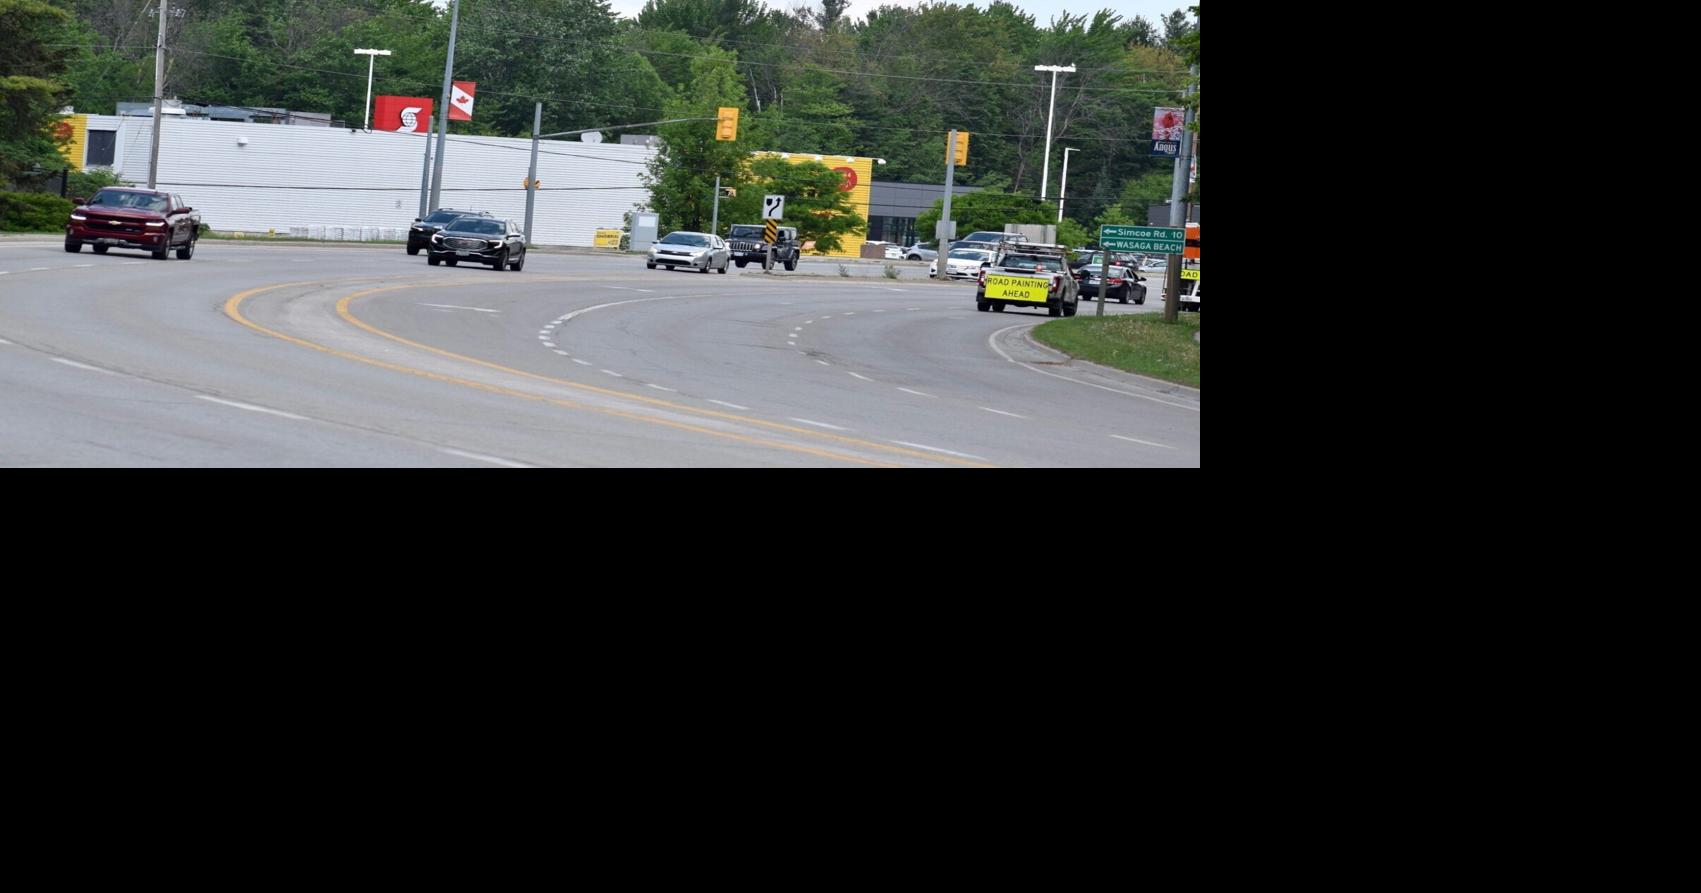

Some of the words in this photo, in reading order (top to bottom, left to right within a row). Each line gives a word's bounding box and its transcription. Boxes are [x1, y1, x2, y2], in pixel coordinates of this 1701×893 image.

[1153, 141, 1177, 153] Angus
[1117, 228, 1152, 237] Simcoe
[1153, 230, 1168, 238] Rd.
[1171, 231, 1183, 239] 10
[1116, 241, 1152, 250] WASAGA
[1153, 243, 1182, 251] BEACH
[987, 277, 1010, 286] ROAD
[1011, 279, 1049, 289] PAINTING
[1002, 289, 1031, 298] AHEAD
